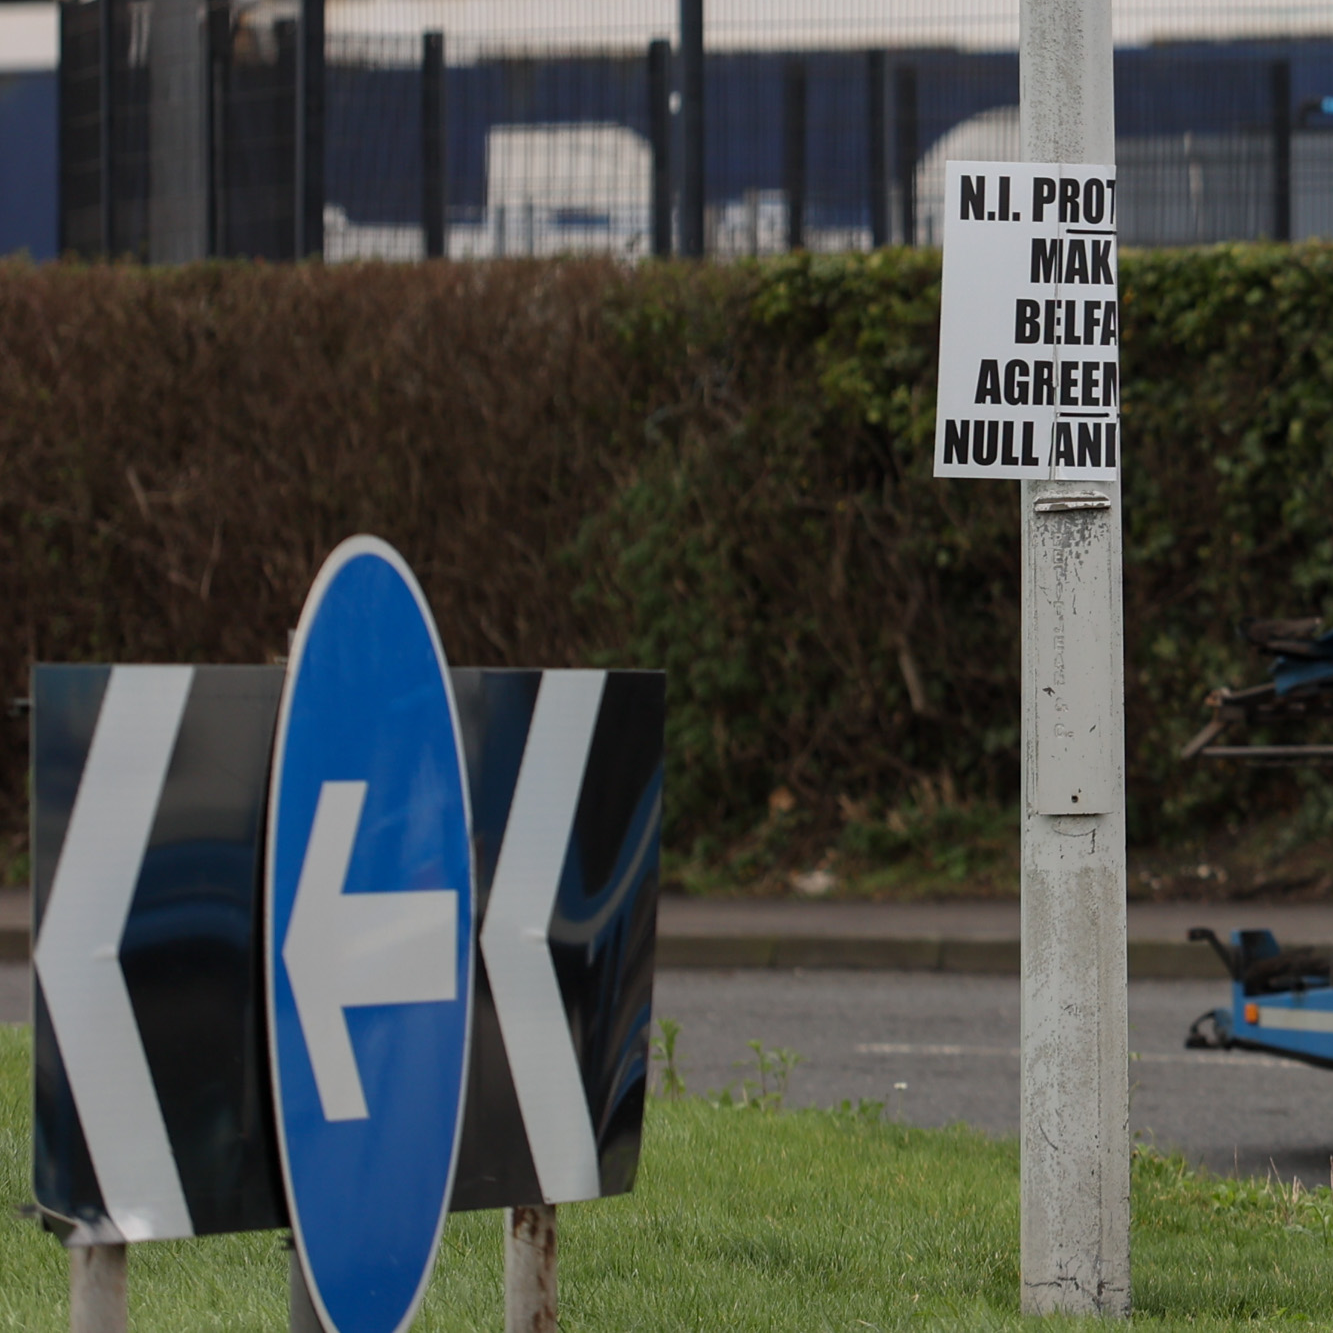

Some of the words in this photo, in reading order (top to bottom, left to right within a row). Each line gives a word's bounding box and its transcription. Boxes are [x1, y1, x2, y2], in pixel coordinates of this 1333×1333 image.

[960, 175, 1021, 221] N.I.
[1030, 238, 1114, 285] MAK
[1014, 299, 1117, 346] BELFA
[943, 420, 1039, 466] NULL
